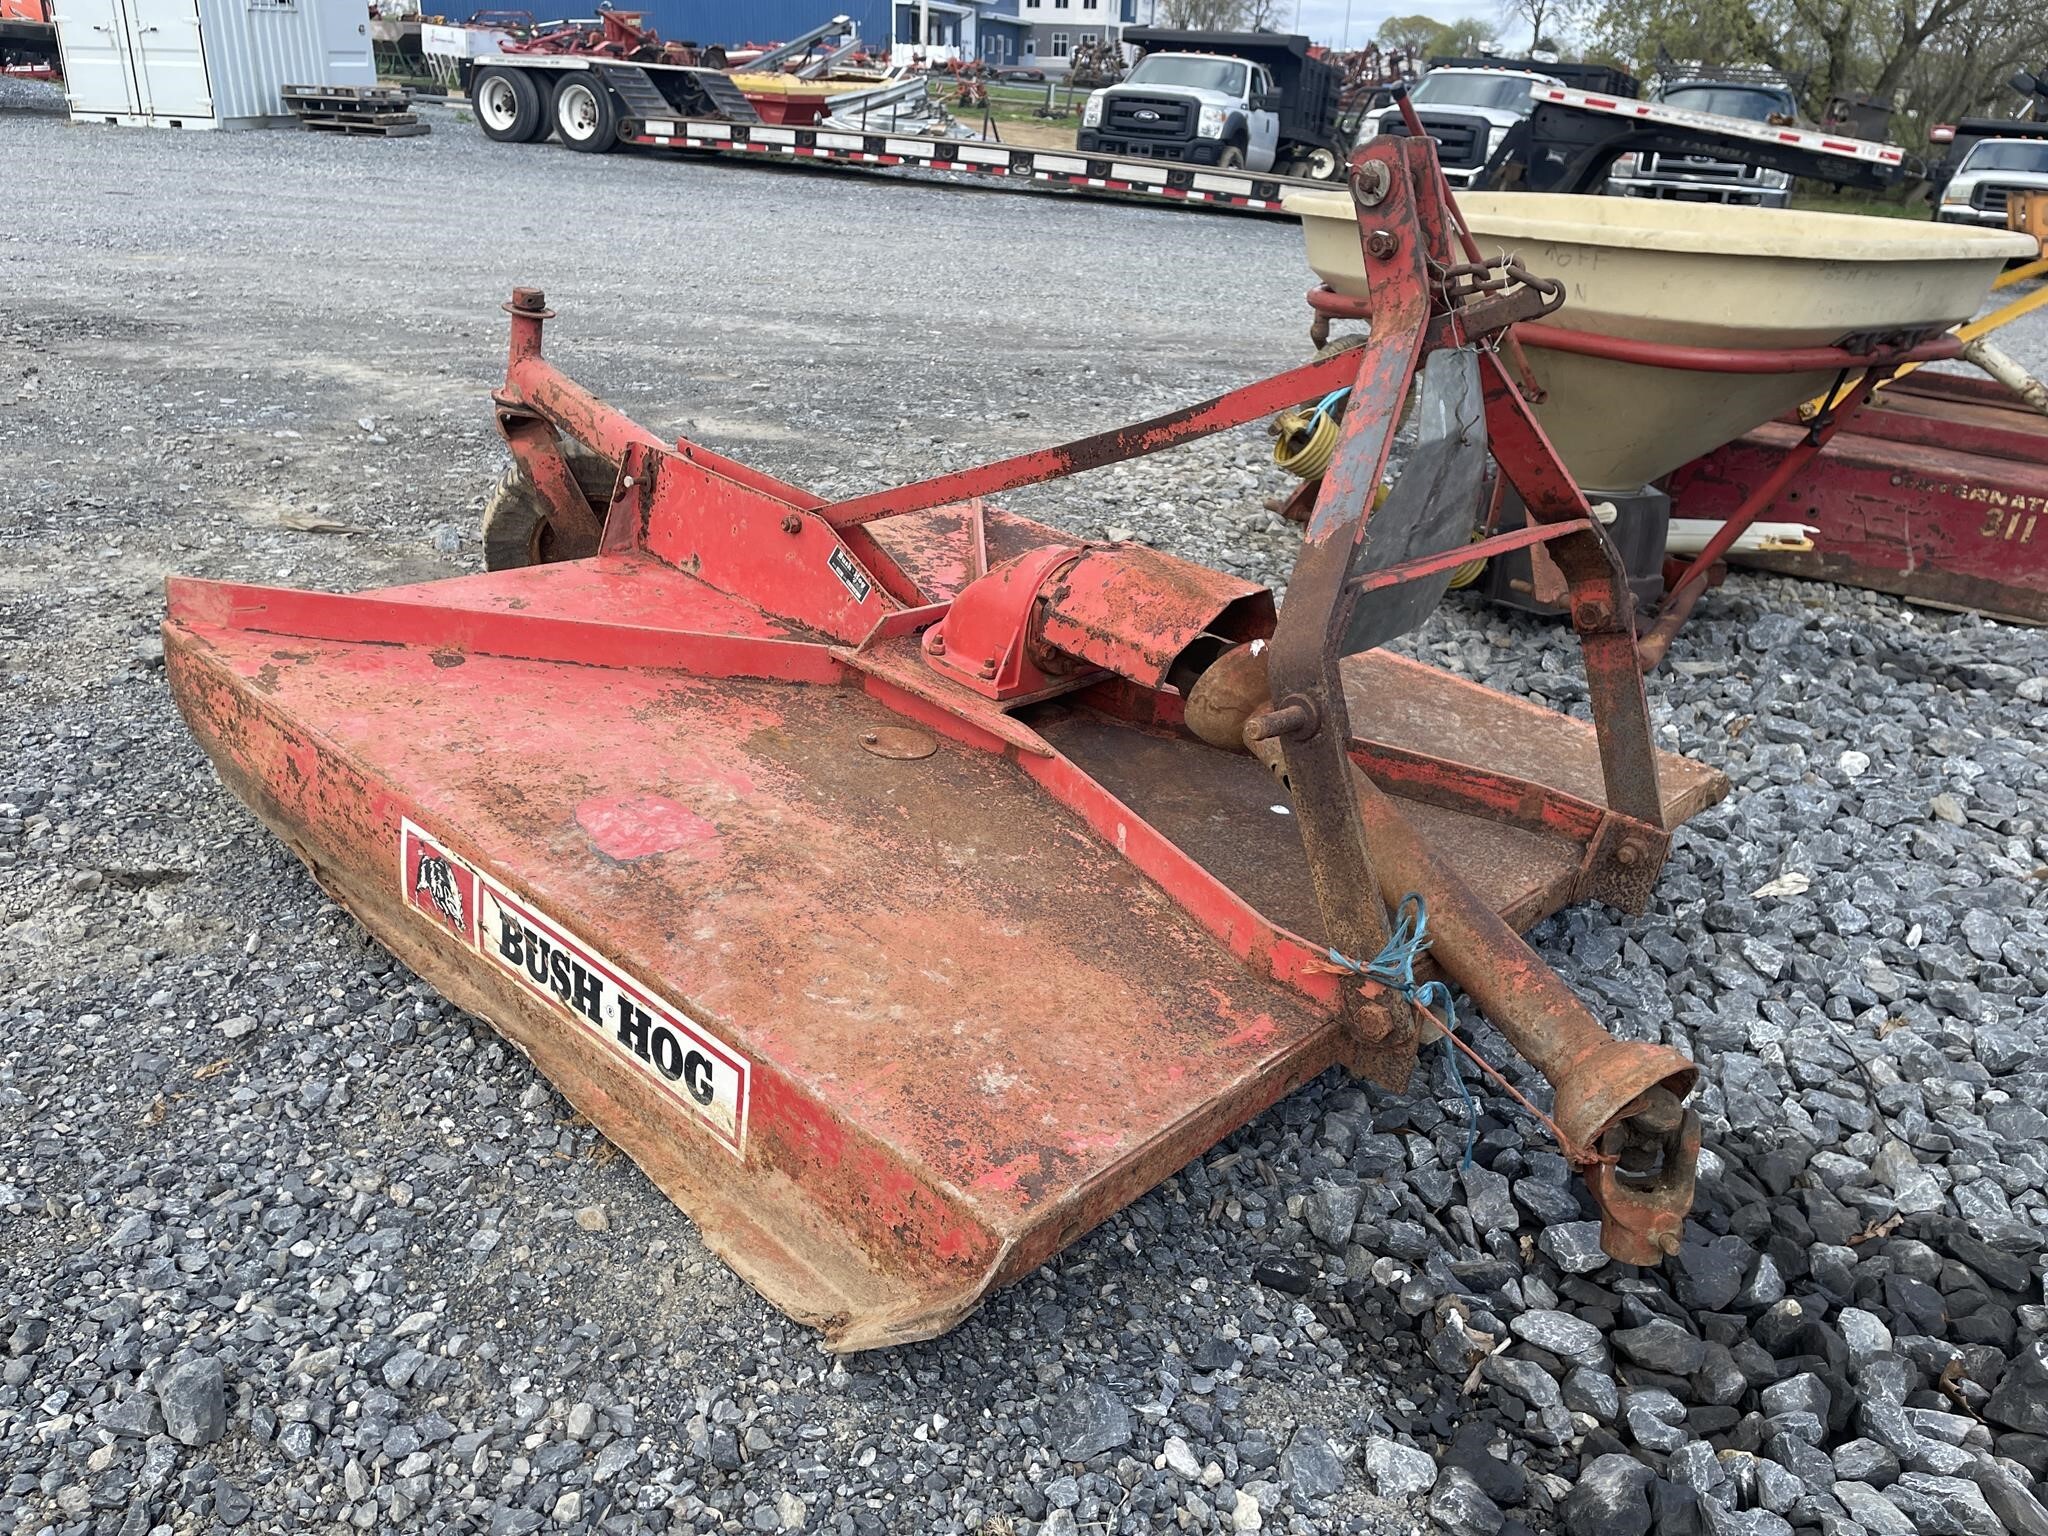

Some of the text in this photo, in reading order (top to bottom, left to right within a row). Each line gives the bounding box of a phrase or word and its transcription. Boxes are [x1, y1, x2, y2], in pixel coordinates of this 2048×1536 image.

[1980, 507, 2037, 544] 311
[499, 910, 714, 1106] BUSH HOG
